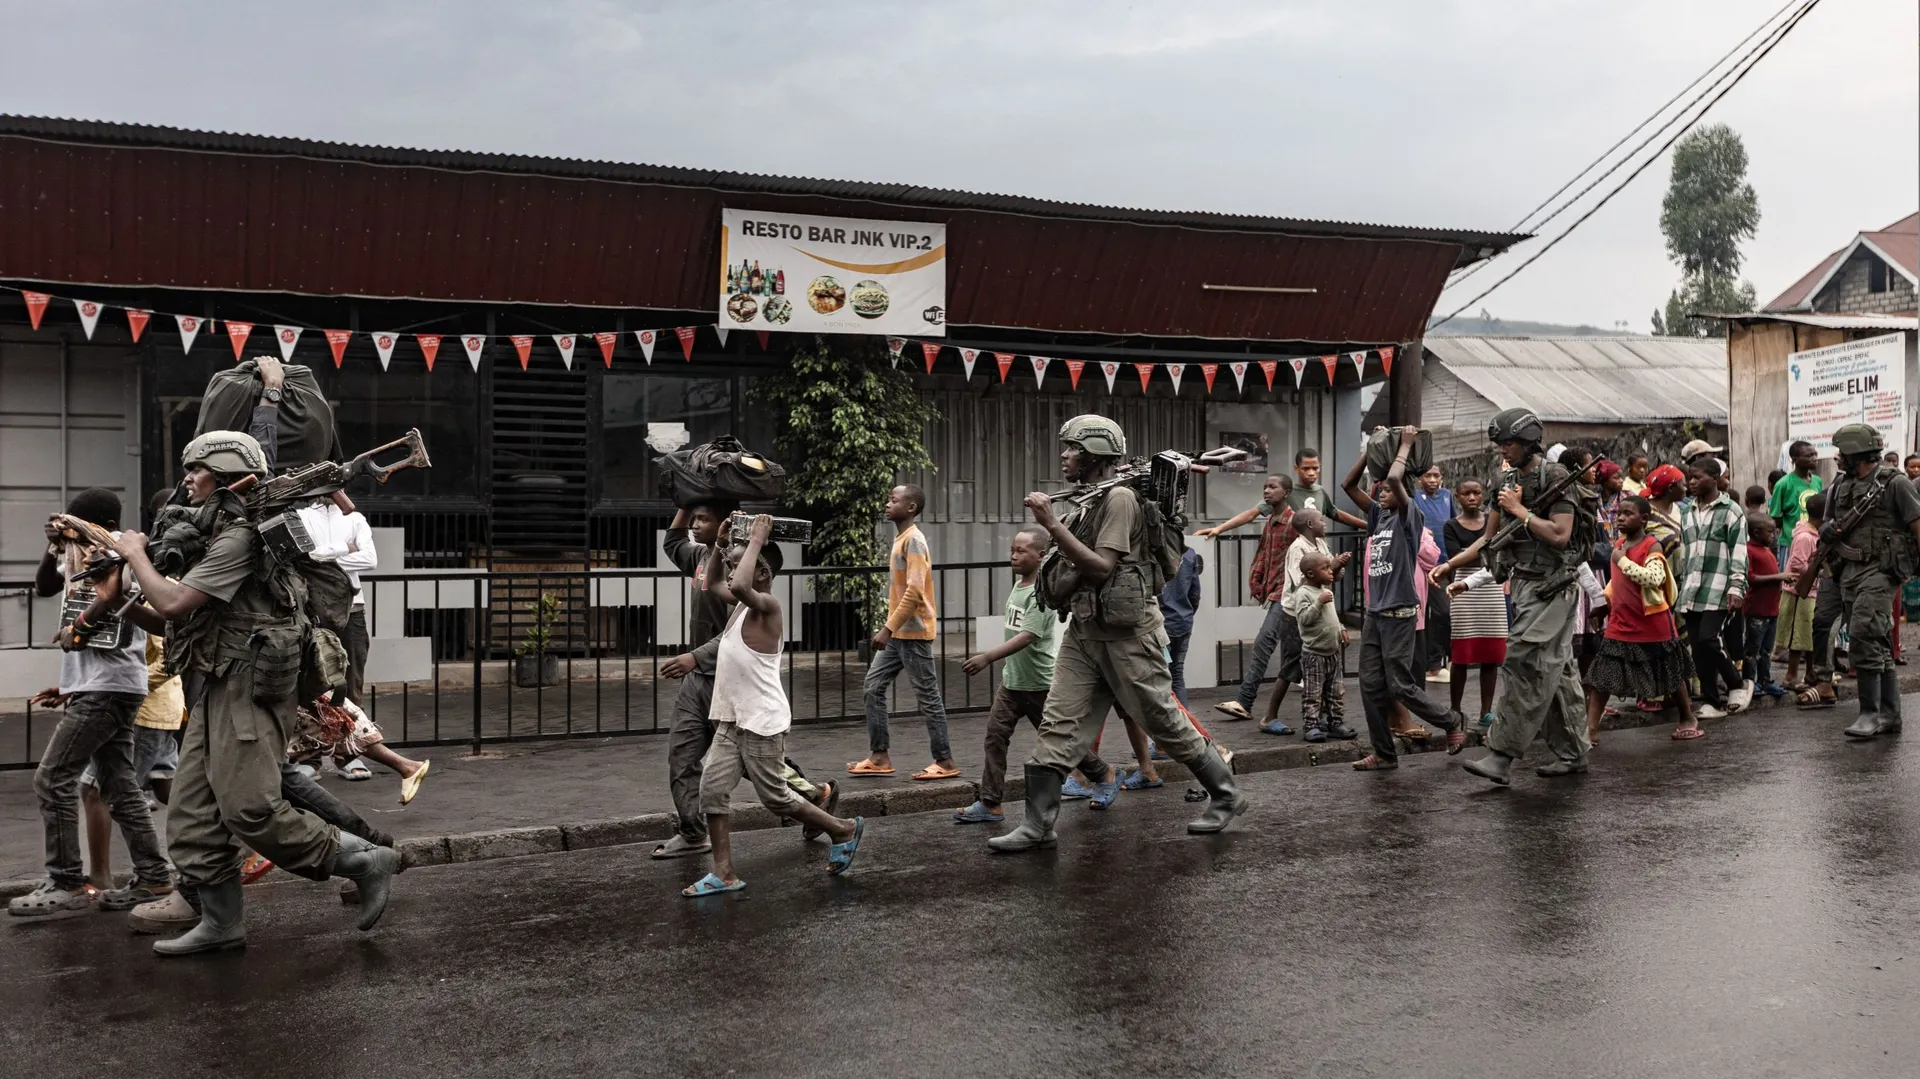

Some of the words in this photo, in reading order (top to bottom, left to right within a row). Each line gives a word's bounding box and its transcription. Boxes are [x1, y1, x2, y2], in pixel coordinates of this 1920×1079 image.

[742, 220, 802, 240] RESTO
[808, 226, 846, 244] BAR
[851, 230, 884, 247] JNK
[888, 232, 932, 250] VIP.2
[1848, 374, 1878, 395] ELIM
